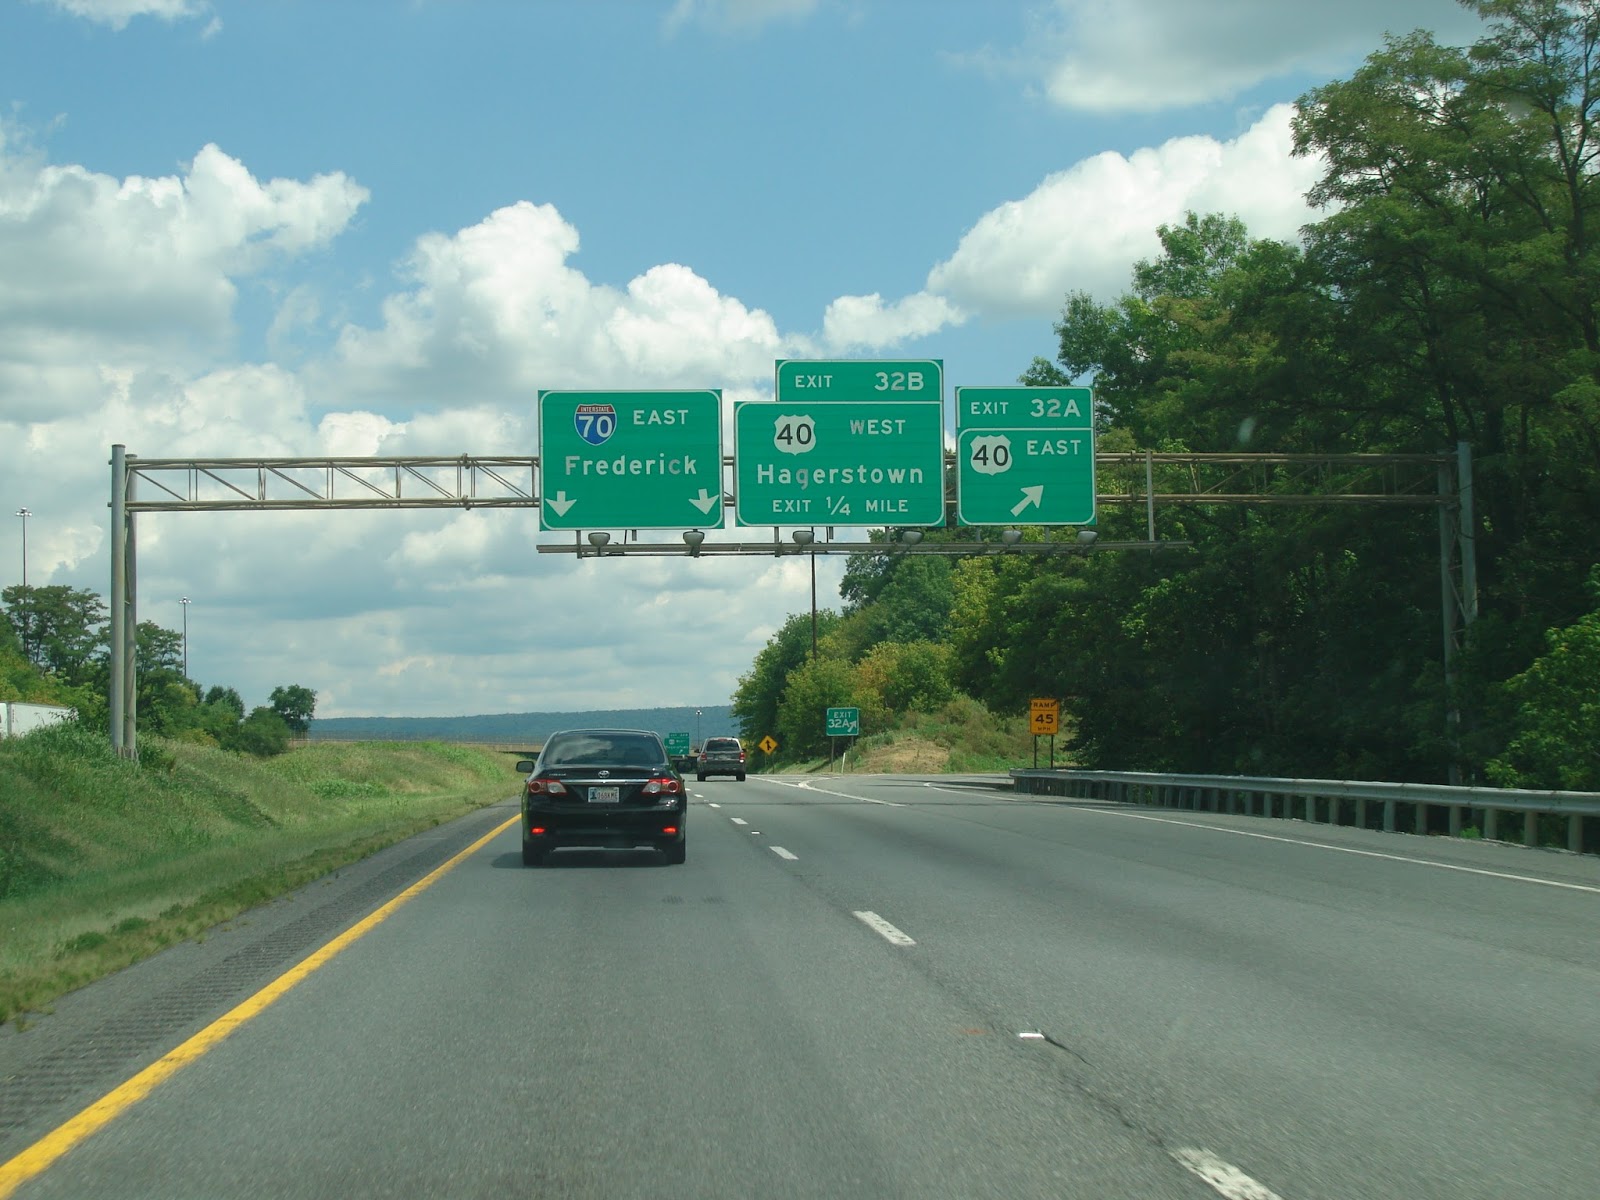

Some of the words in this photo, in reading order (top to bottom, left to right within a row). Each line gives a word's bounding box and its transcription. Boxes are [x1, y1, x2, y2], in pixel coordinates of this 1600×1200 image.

[795, 375, 833, 388] EXIT
[874, 371, 925, 391] 32B
[633, 410, 689, 425] EAST
[970, 401, 1009, 415] EXIT
[1029, 398, 1081, 418] 32A
[578, 415, 613, 438] 70
[776, 423, 812, 446] 40
[850, 419, 906, 435] WEST
[972, 444, 1009, 466] 40
[1026, 440, 1082, 456] EAST
[565, 453, 697, 476] Frederick
[757, 464, 924, 490] Hagerstown
[772, 499, 812, 512] EXIT
[865, 499, 909, 512] MILE
[828, 719, 850, 728] 32A
[1035, 713, 1054, 724] 45
